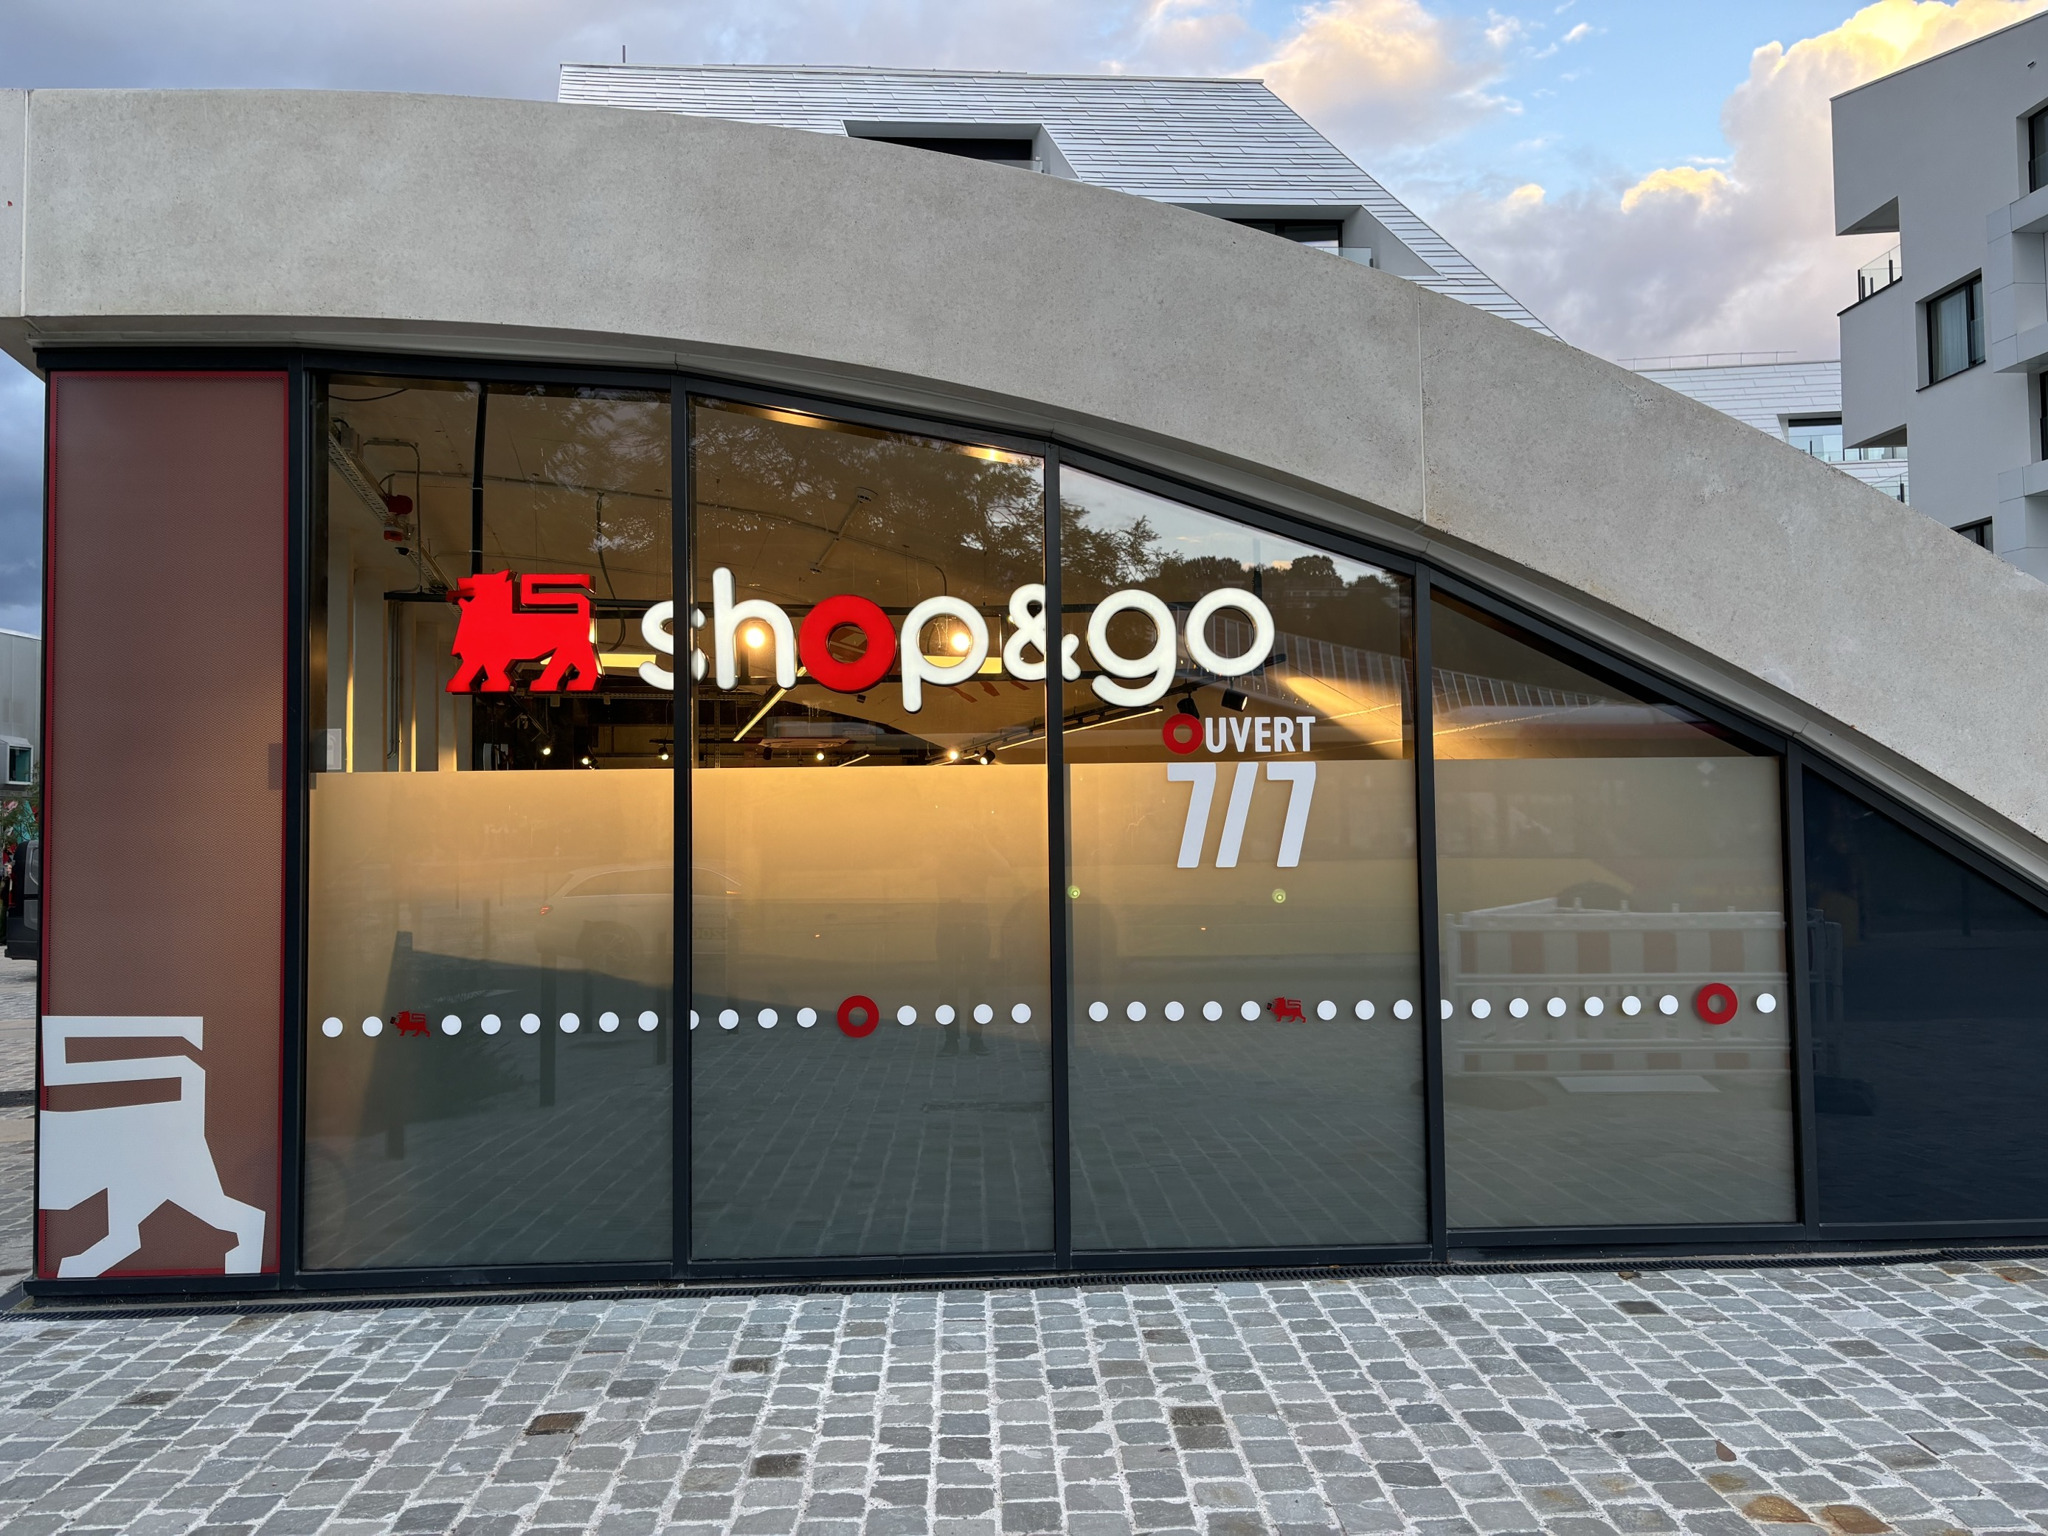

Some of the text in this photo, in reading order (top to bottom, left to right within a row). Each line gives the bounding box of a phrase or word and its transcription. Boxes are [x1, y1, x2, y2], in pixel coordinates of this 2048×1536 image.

[638, 567, 1275, 713] shop&go
[1162, 713, 1316, 755] OUVERT
[1167, 761, 1316, 868] 7/7
